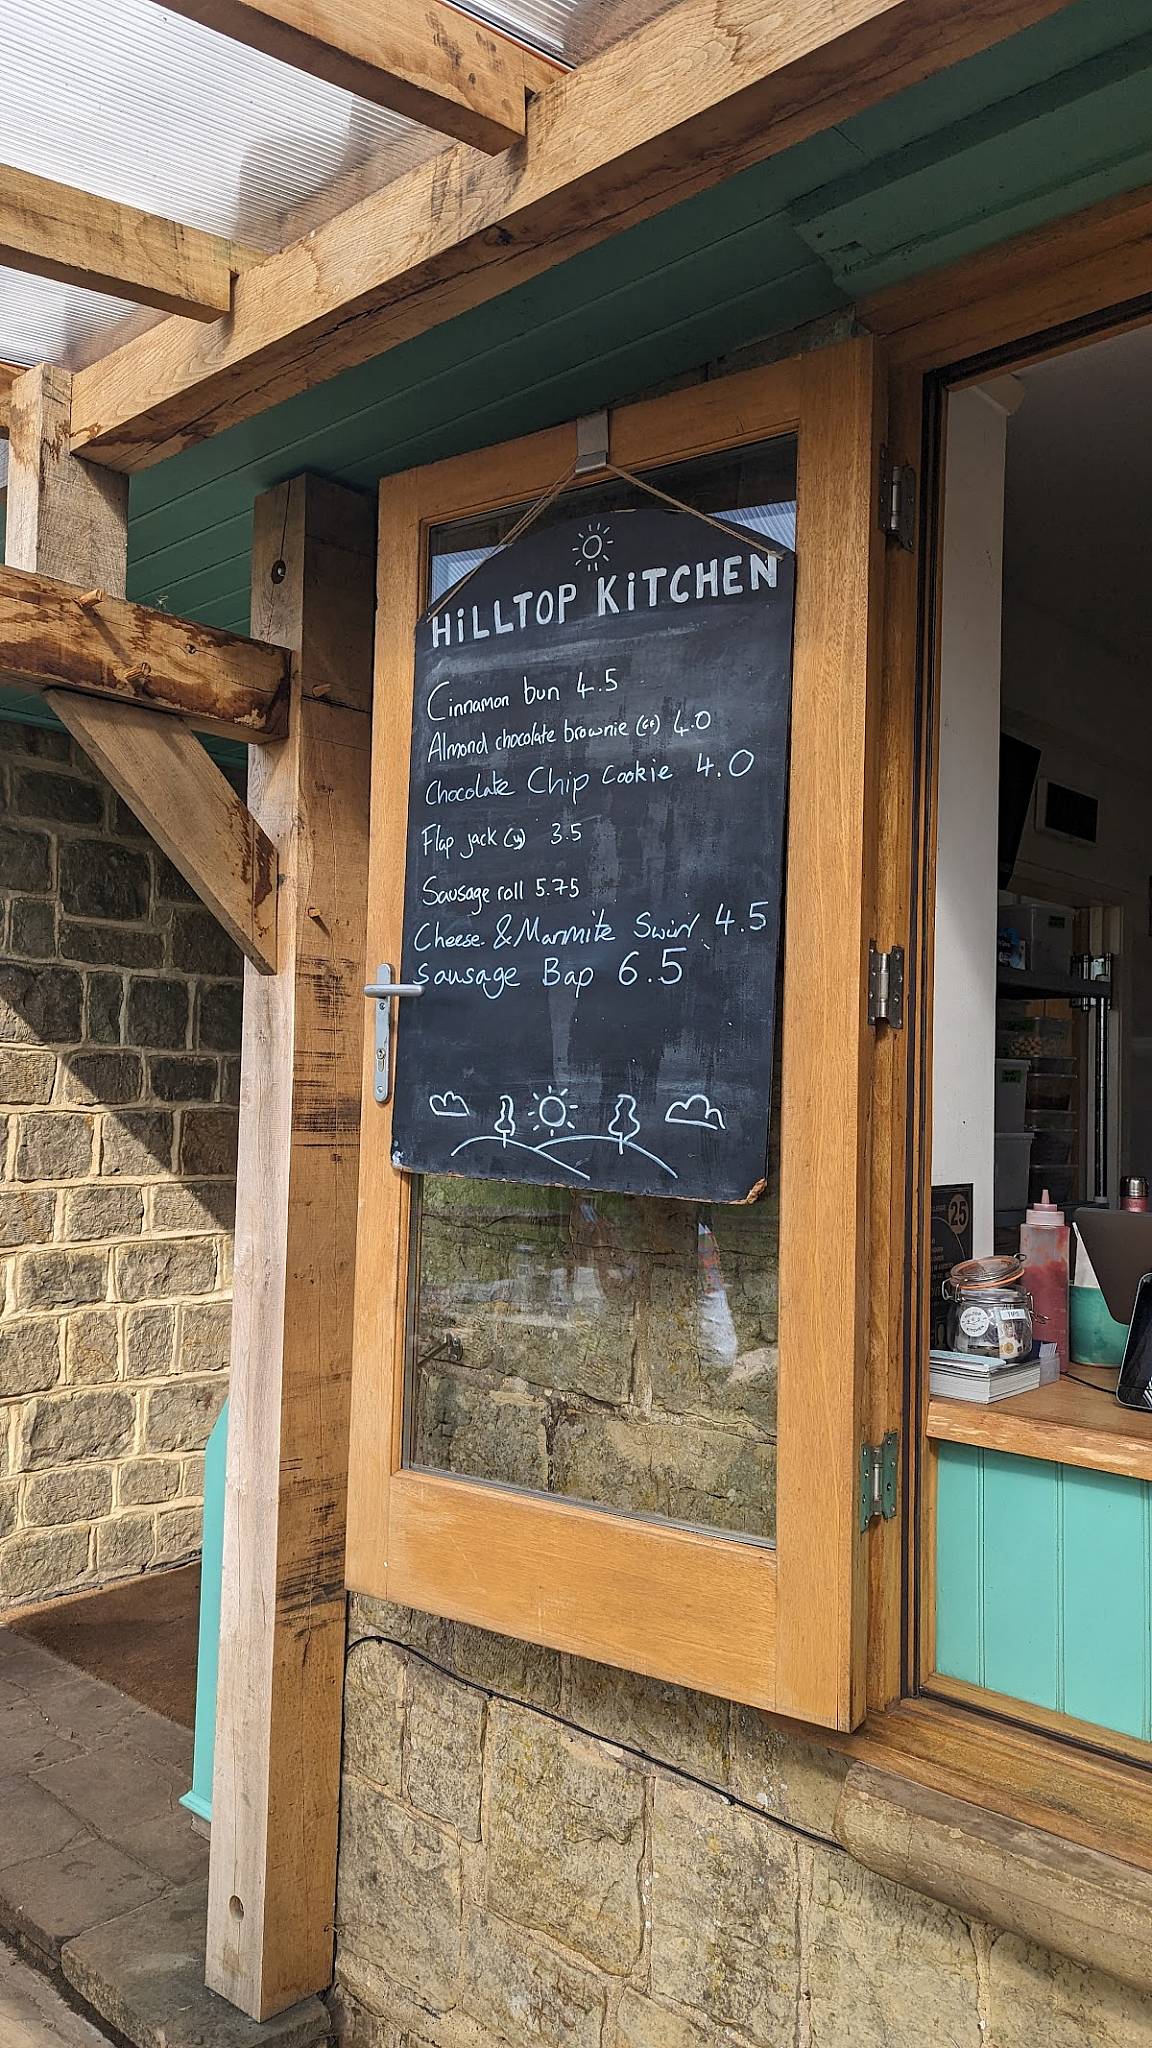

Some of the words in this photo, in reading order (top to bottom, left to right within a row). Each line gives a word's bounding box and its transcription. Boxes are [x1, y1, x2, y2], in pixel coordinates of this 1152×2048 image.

[427, 680, 510, 721] Cinnamon
[523, 676, 560, 705] bun
[576, 667, 618, 699] 4.5
[427, 731, 489, 763] Almond
[495, 721, 557, 751] chocolate
[564, 718, 630, 743] brownie
[673, 709, 711, 737] 4.0
[425, 770, 515, 805] Chocolate
[527, 766, 590, 805] Chip
[601, 758, 673, 785] Cookie
[696, 749, 755, 778] 4.0
[550, 822, 582, 845] 3.5
[422, 875, 490, 916] Sausage
[497, 880, 523, 901] roll
[535, 877, 580, 898] 5.75
[413, 921, 486, 952] Cheese
[633, 911, 701, 940] Swirl
[715, 901, 769, 936] 4.5
[542, 957, 594, 999] Bap
[618, 947, 687, 986] 6.5
[950, 1200, 967, 1226] 25
